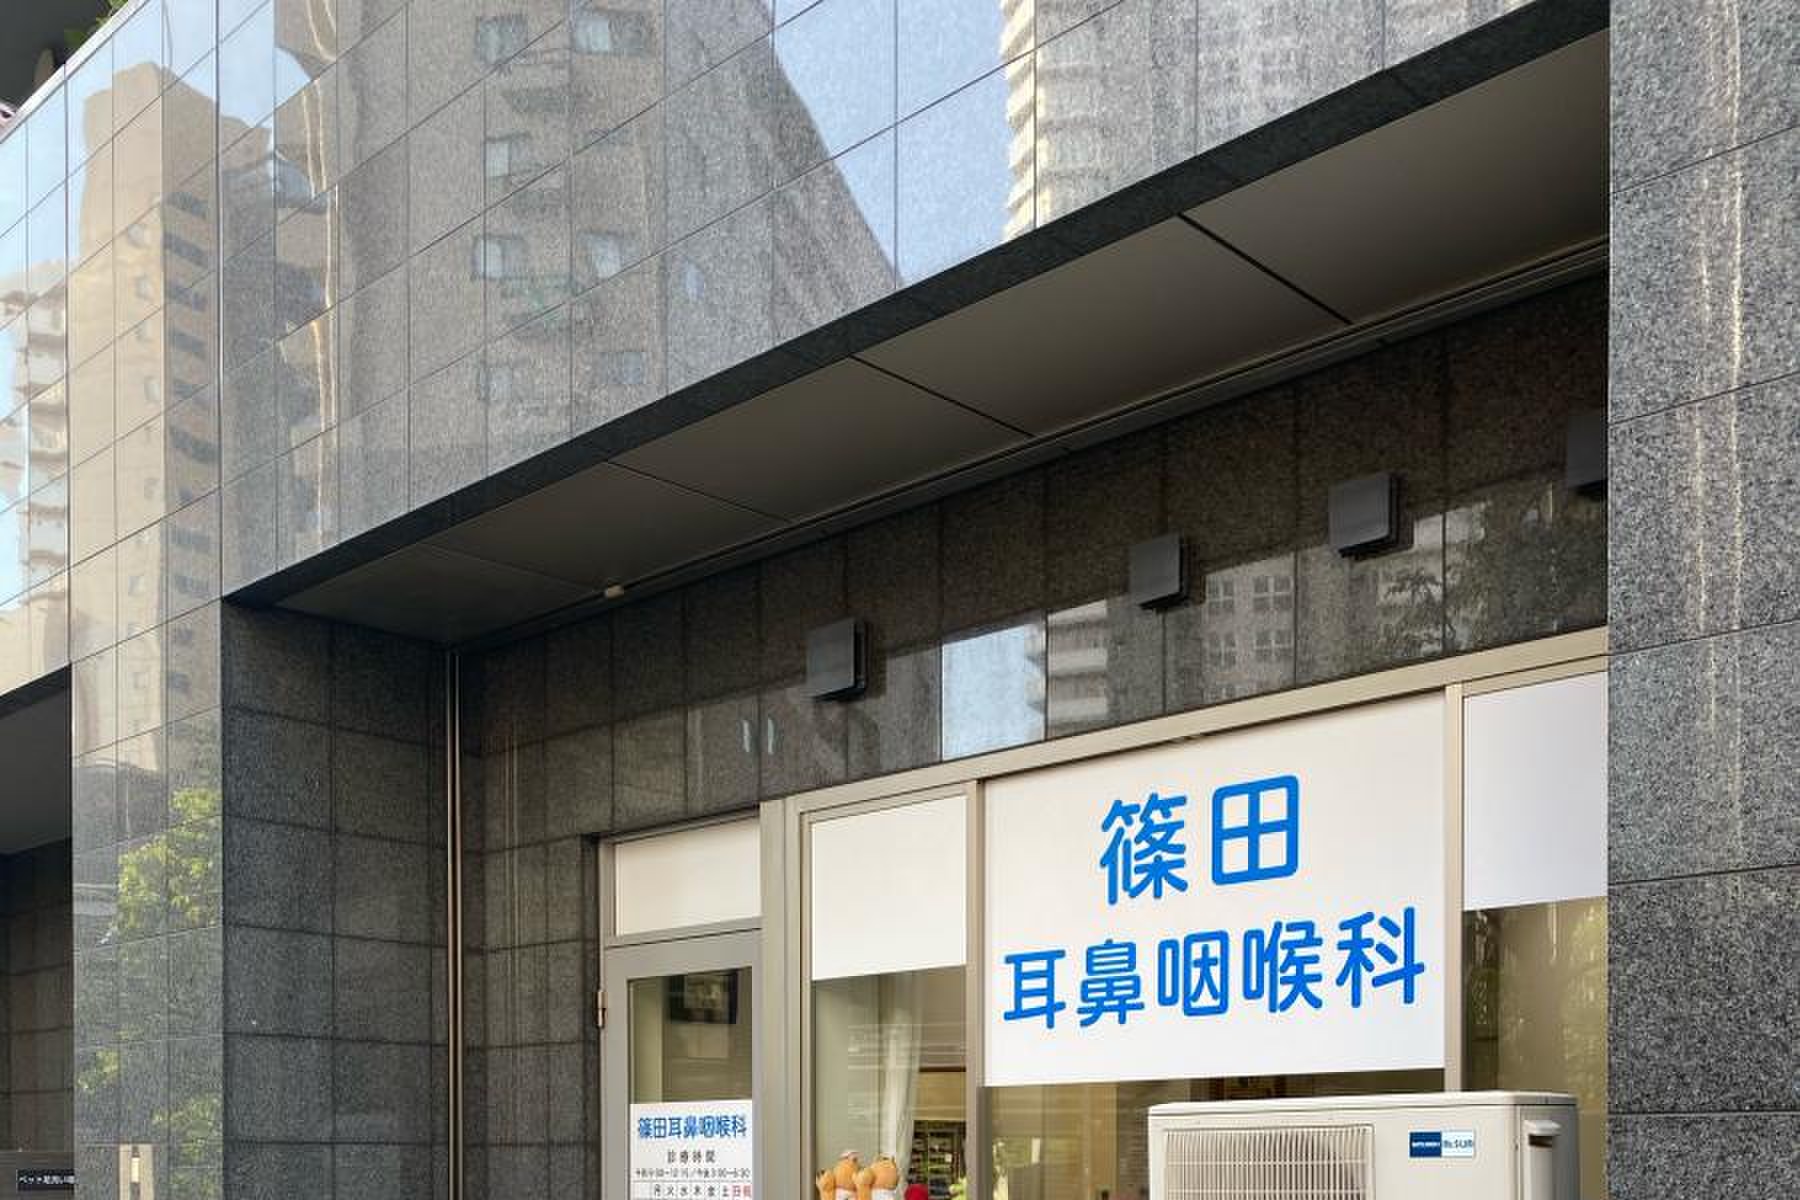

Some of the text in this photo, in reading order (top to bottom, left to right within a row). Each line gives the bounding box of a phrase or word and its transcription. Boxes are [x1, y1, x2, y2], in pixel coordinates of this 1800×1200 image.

[1100, 775, 1299, 905] 篠田
[1003, 907, 1425, 1028] 耳鼻咽喉科
[638, 1115, 747, 1139] 篠田耳鼻咽喉科
